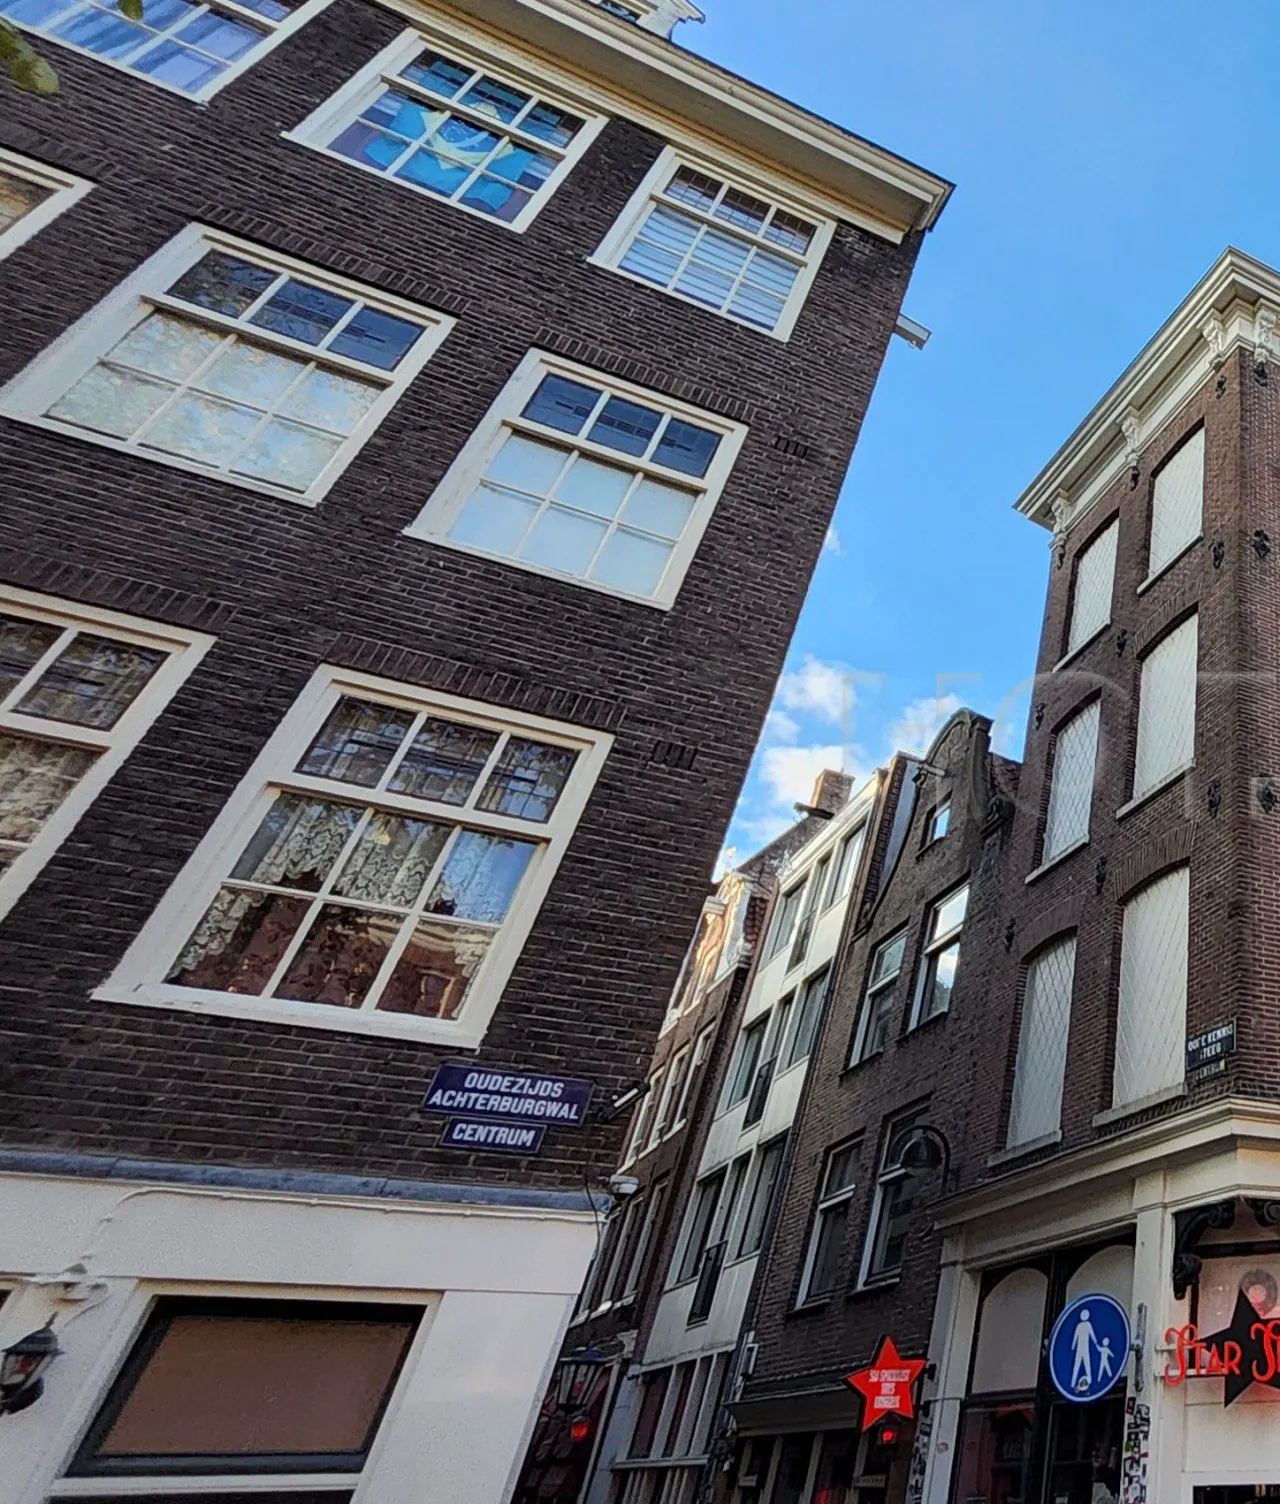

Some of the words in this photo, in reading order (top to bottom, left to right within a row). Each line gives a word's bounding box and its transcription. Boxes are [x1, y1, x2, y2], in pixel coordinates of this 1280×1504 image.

[464, 1072, 565, 1098] OUDEZIJDS
[428, 1089, 579, 1120] ACHTERBURGWAL
[452, 1123, 536, 1147] CENTRUM
